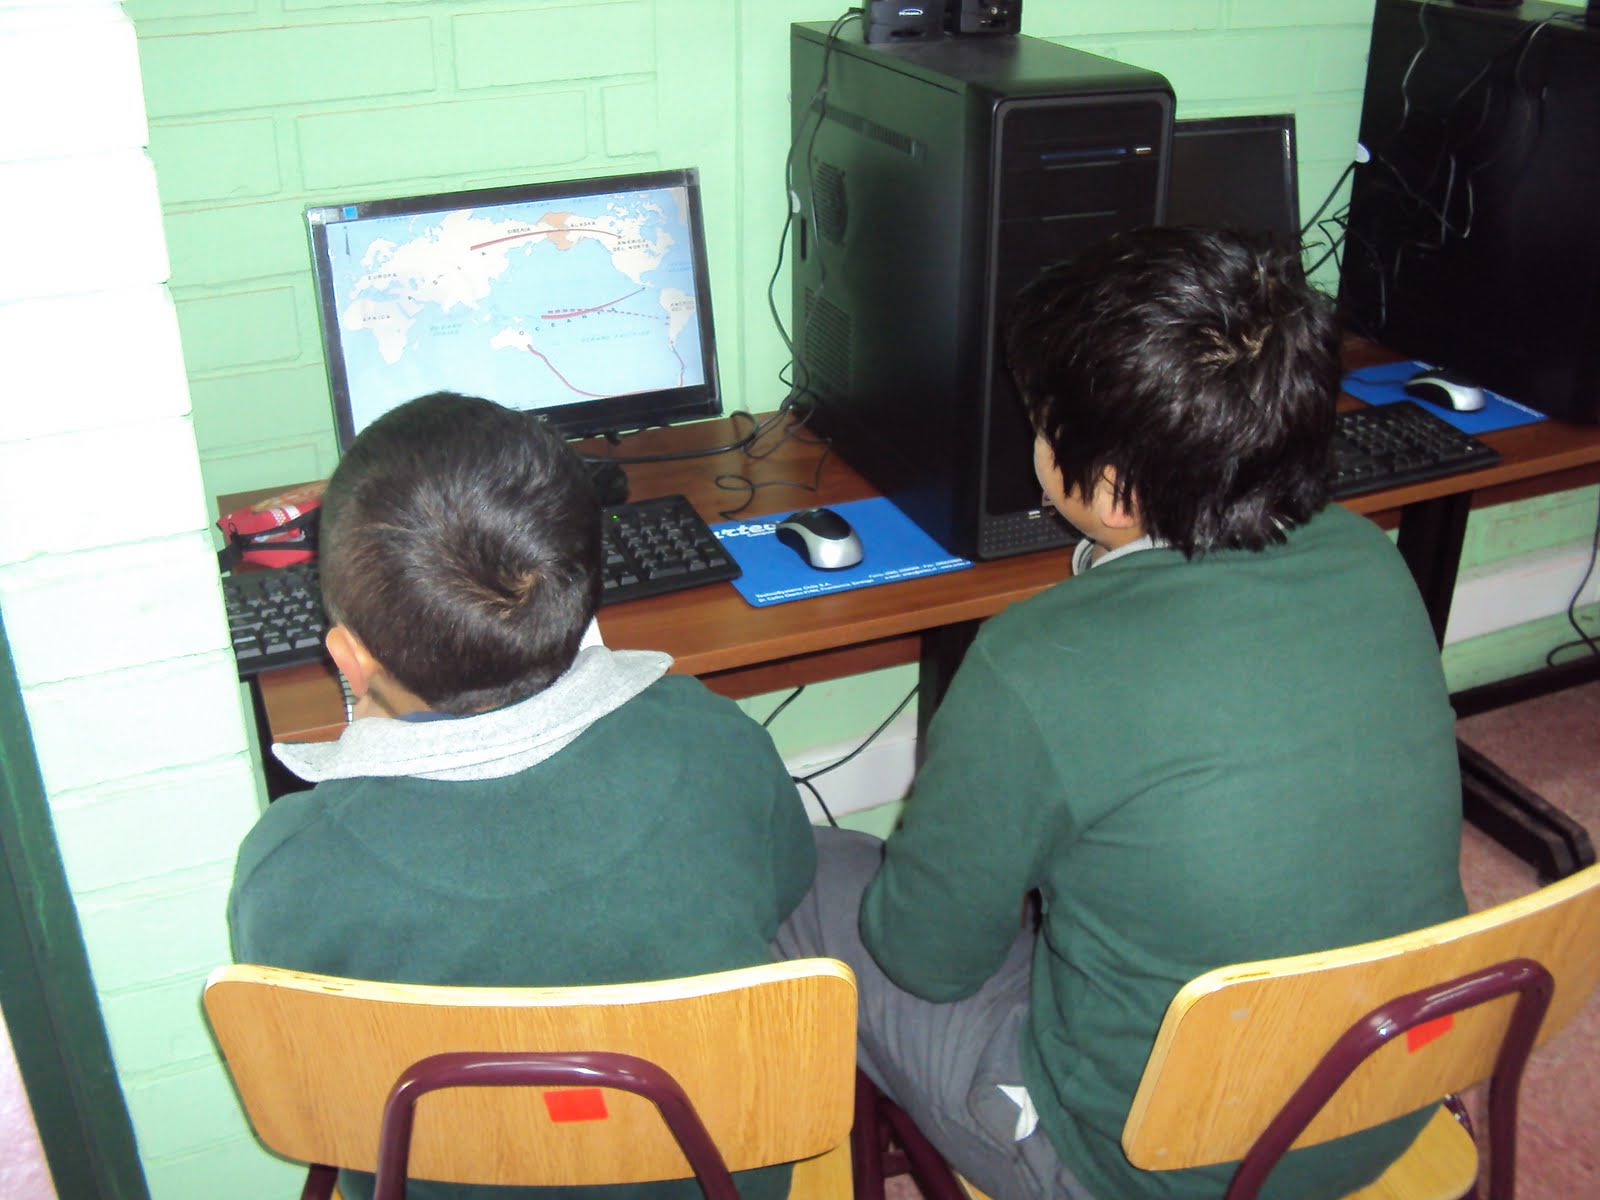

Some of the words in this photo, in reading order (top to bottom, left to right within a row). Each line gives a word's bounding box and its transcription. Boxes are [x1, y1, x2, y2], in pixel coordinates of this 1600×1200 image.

[507, 226, 531, 235] SIBERIA
[628, 243, 650, 251] NORTE
[368, 272, 397, 281] EUROPA
